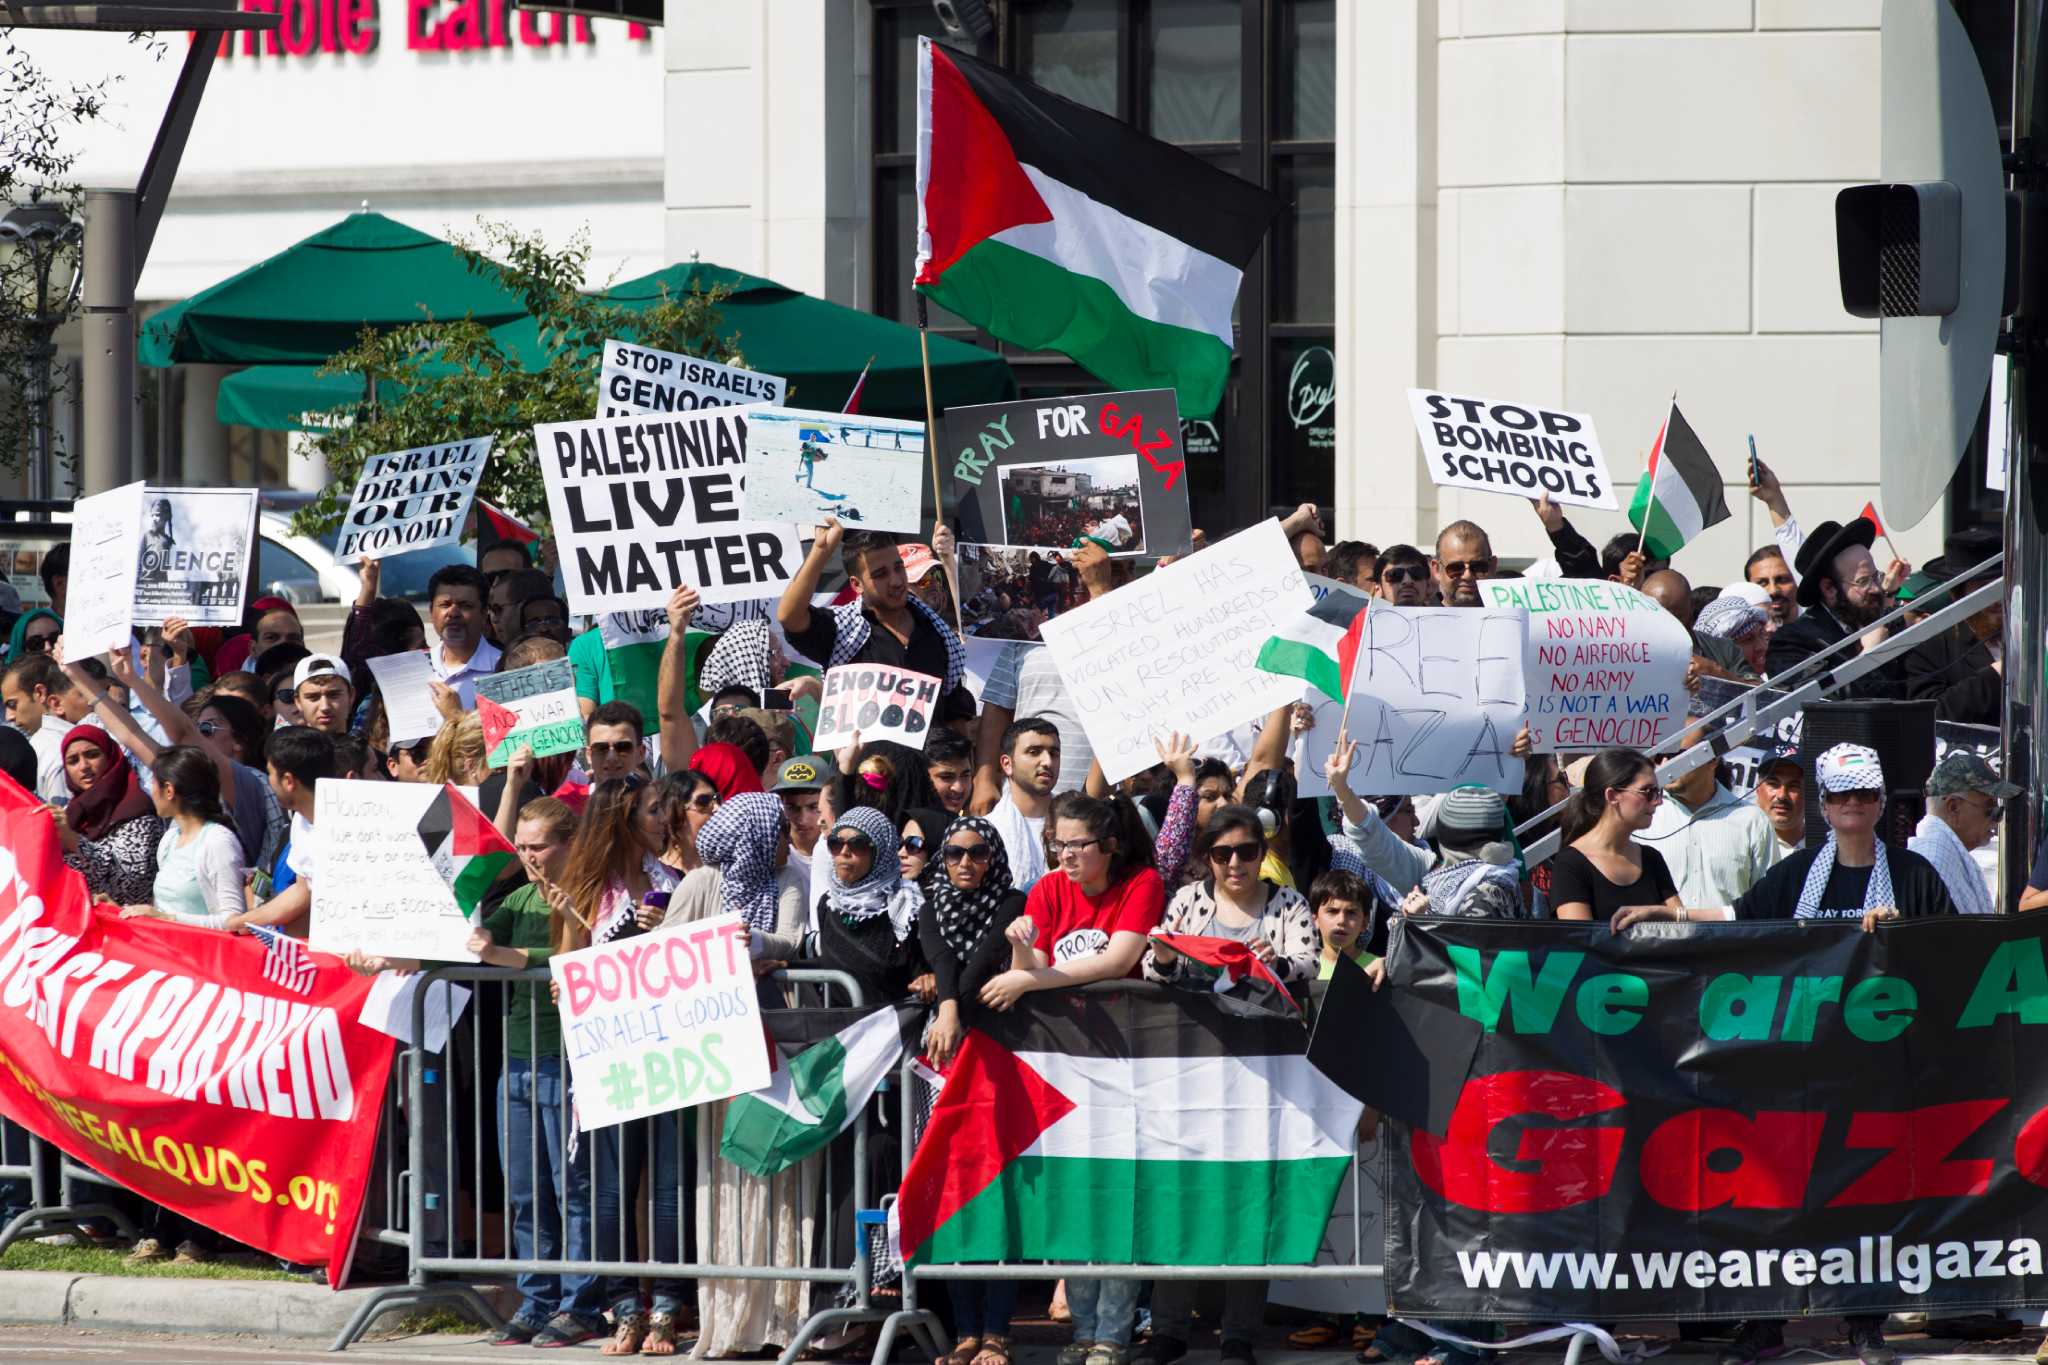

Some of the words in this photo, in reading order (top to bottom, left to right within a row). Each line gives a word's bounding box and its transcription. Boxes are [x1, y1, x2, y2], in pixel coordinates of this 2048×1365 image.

[615, 348, 673, 375] STOP
[680, 361, 777, 401] ISRAEL'S
[1425, 395, 1582, 435] STOP
[372, 444, 477, 478] ISRAEL
[953, 413, 1015, 486] PRAY
[1036, 404, 1091, 440] FOR
[1099, 402, 1187, 492] GAZA
[1432, 421, 1595, 468] BOMBING
[358, 466, 475, 503] DRAINS
[1441, 452, 1601, 499] SCHOOLS
[353, 491, 462, 526] OUR
[564, 473, 746, 533] LIVE
[342, 514, 460, 556] ECONOMY
[576, 532, 790, 595] MATTER
[1060, 588, 1184, 660] ISRAEL
[1192, 556, 1253, 594] HAS
[1492, 582, 1608, 612] PALESTINE
[1067, 635, 1160, 684] VIOLATED
[1173, 586, 1278, 640] HUNDREDS
[1281, 568, 1305, 592] OF
[1547, 618, 1574, 639] NO
[1579, 616, 1625, 639] NAVY
[1367, 609, 1522, 706] REE
[1539, 645, 1567, 666] NO
[1573, 642, 1652, 666] AIRFORCE
[494, 674, 536, 700] THIS
[827, 671, 936, 704] ENOUGH
[1076, 682, 1128, 714] UN
[1119, 690, 1171, 722] WHY
[1180, 668, 1221, 696] ARE
[1550, 672, 1579, 692] NO
[1583, 670, 1636, 692] ARMY
[530, 701, 565, 722] WAR
[818, 700, 926, 736] BLOOD
[1186, 691, 1237, 724] WITH
[1538, 696, 1554, 713] IS
[1560, 696, 1599, 714] NOT
[1606, 697, 1617, 713] A
[1626, 693, 1669, 714] WAR
[1555, 717, 1669, 745] GENOCIDE
[1816, 907, 1838, 919] RAY
[562, 921, 744, 1017] BOYCOTT
[1446, 944, 1650, 1035] We
[1700, 970, 1918, 1043] are
[570, 1003, 670, 1060] ISRAELI
[674, 986, 749, 1031] GOODS
[600, 1032, 734, 1111] #BDS
[1411, 1069, 2048, 1215] Gaz
[1457, 1234, 2044, 1296] www.weareallgaza
